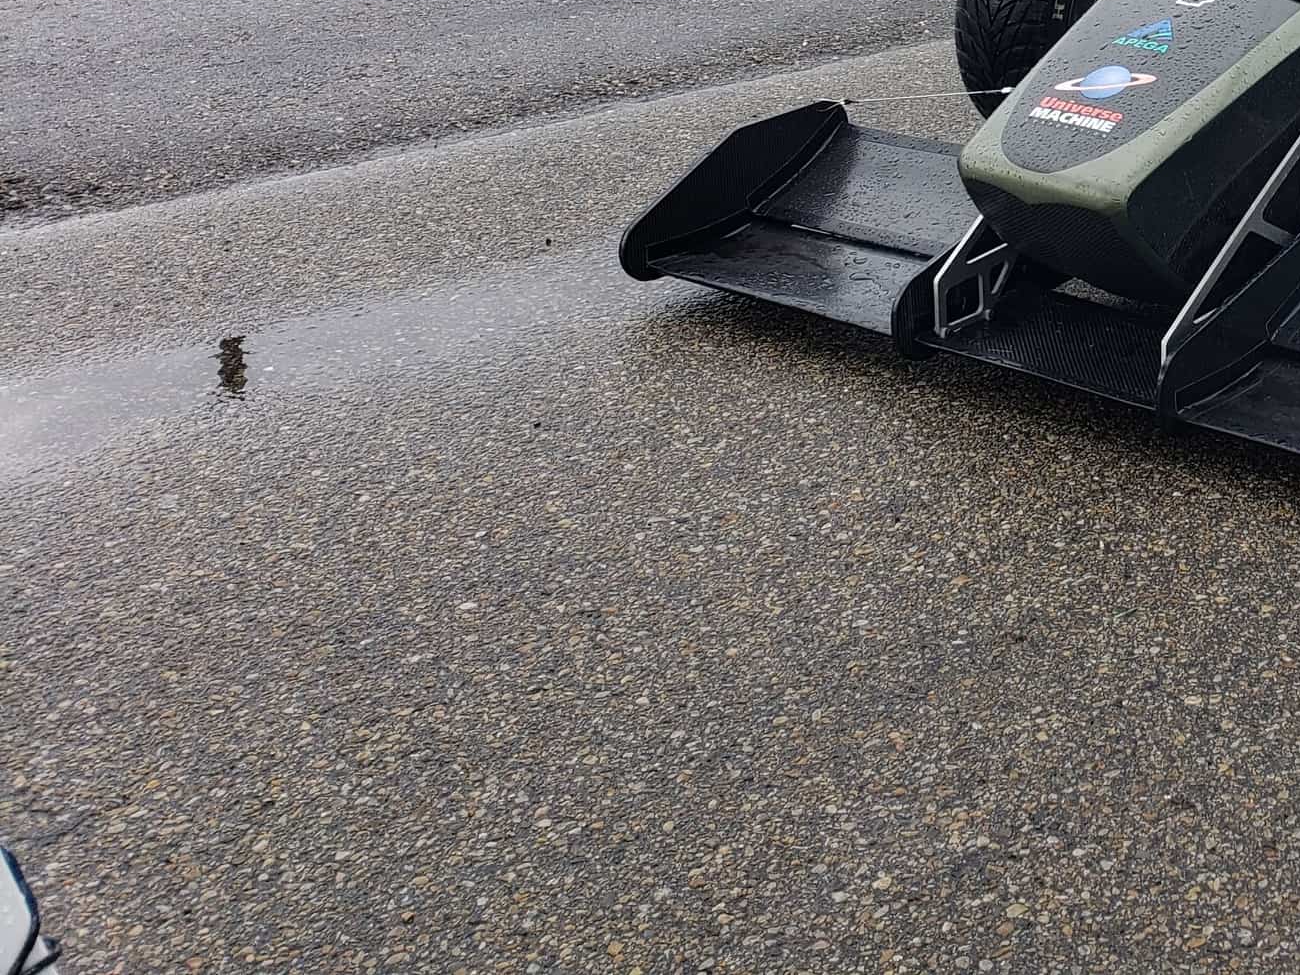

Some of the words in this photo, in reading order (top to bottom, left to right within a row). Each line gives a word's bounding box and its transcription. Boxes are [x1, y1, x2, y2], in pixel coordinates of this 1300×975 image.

[1112, 36, 1169, 55] APEGA
[1029, 106, 1117, 133] MACHINE
[1039, 96, 1124, 122] Universe
